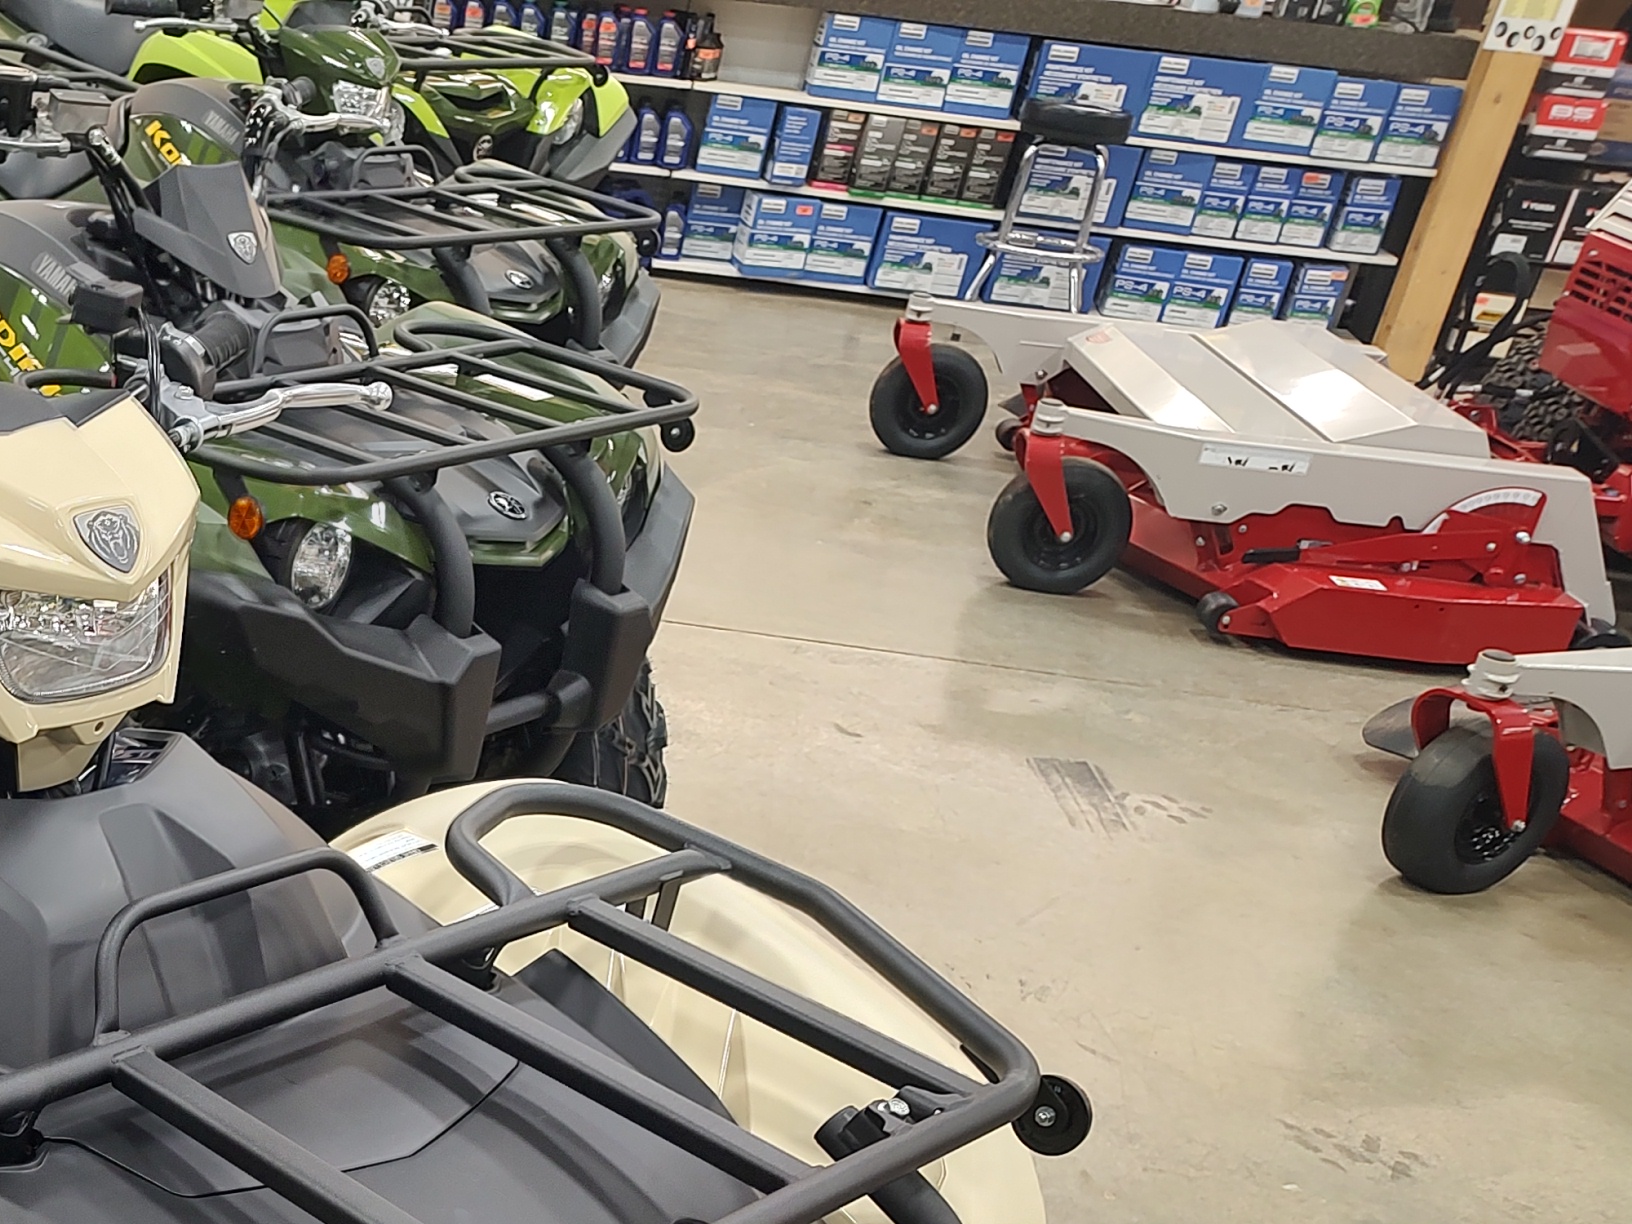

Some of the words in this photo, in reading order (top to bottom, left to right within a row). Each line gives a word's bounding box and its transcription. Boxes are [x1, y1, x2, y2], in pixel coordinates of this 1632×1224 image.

[1548, 104, 1596, 120] BS
[204, 110, 241, 145] YAMAHA
[1325, 116, 1359, 129] PS-4
[1390, 122, 1424, 134] PS-4
[1115, 280, 1148, 292] PS-4
[1173, 286, 1206, 298] PS-4
